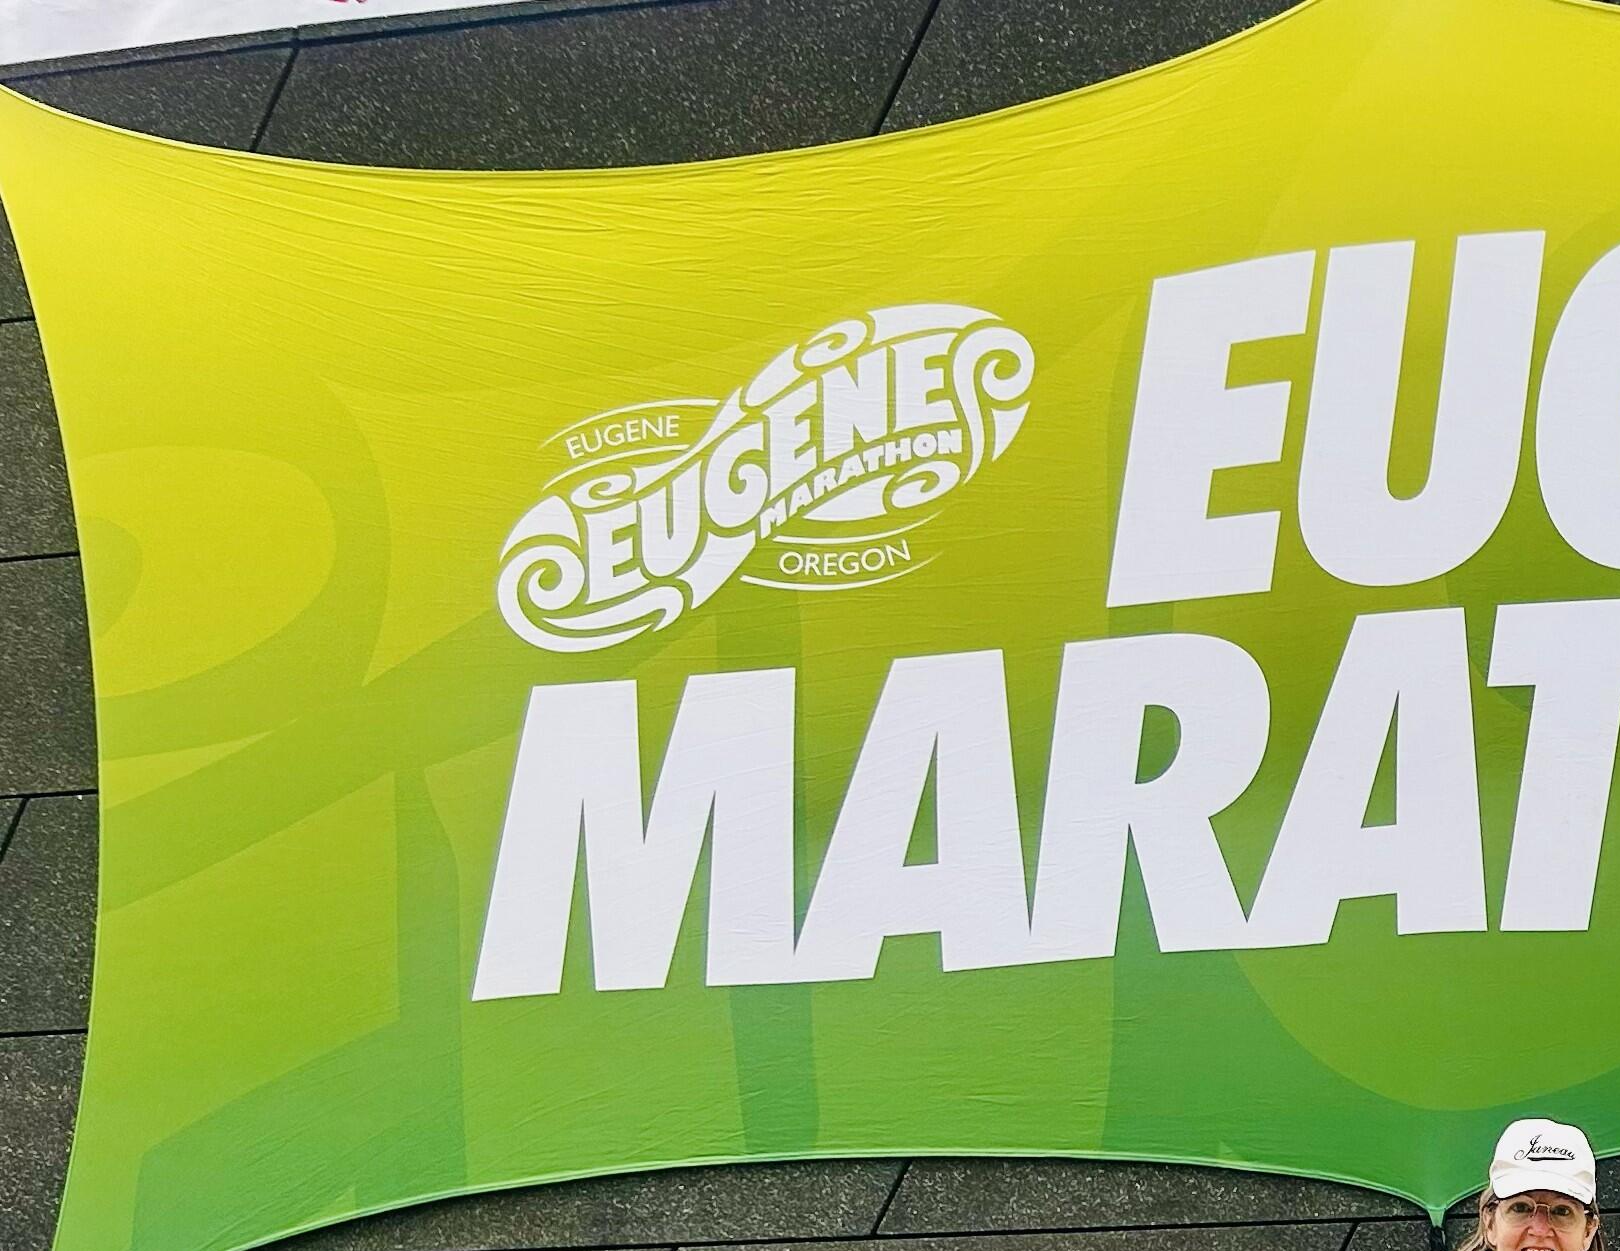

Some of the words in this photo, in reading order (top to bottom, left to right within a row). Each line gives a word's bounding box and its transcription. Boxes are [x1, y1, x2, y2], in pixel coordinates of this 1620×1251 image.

[565, 415, 680, 460] EUGENE
[585, 332, 960, 605] EUGENE
[760, 429, 964, 539] MARATHON
[778, 539, 912, 577] OREGON
